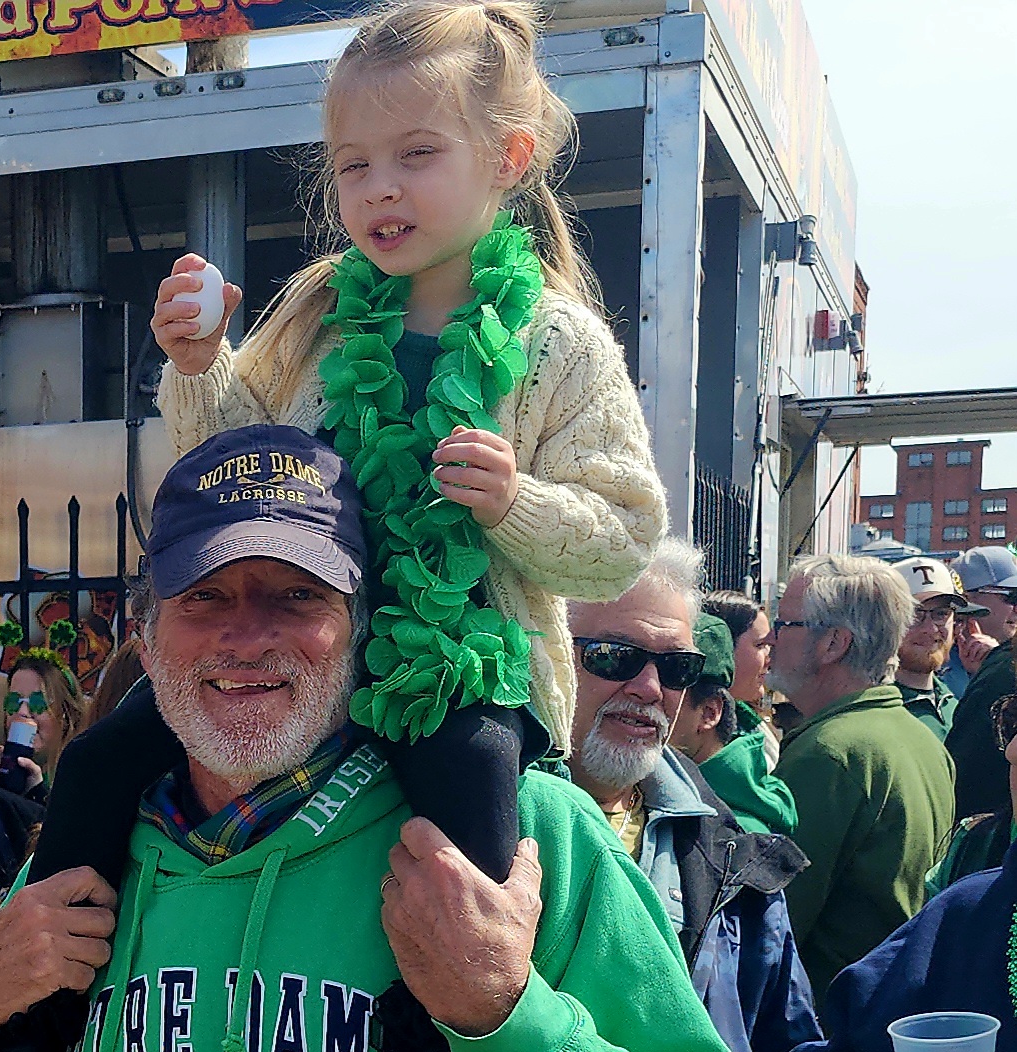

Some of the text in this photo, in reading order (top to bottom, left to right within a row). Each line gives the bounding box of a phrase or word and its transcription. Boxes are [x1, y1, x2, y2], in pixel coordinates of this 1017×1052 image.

[47, 0, 223, 29] Po
[196, 452, 327, 497] NOTRE DAME
[218, 488, 307, 505] LACROSSE
[912, 565, 935, 586] T
[291, 744, 389, 837] IRISH
